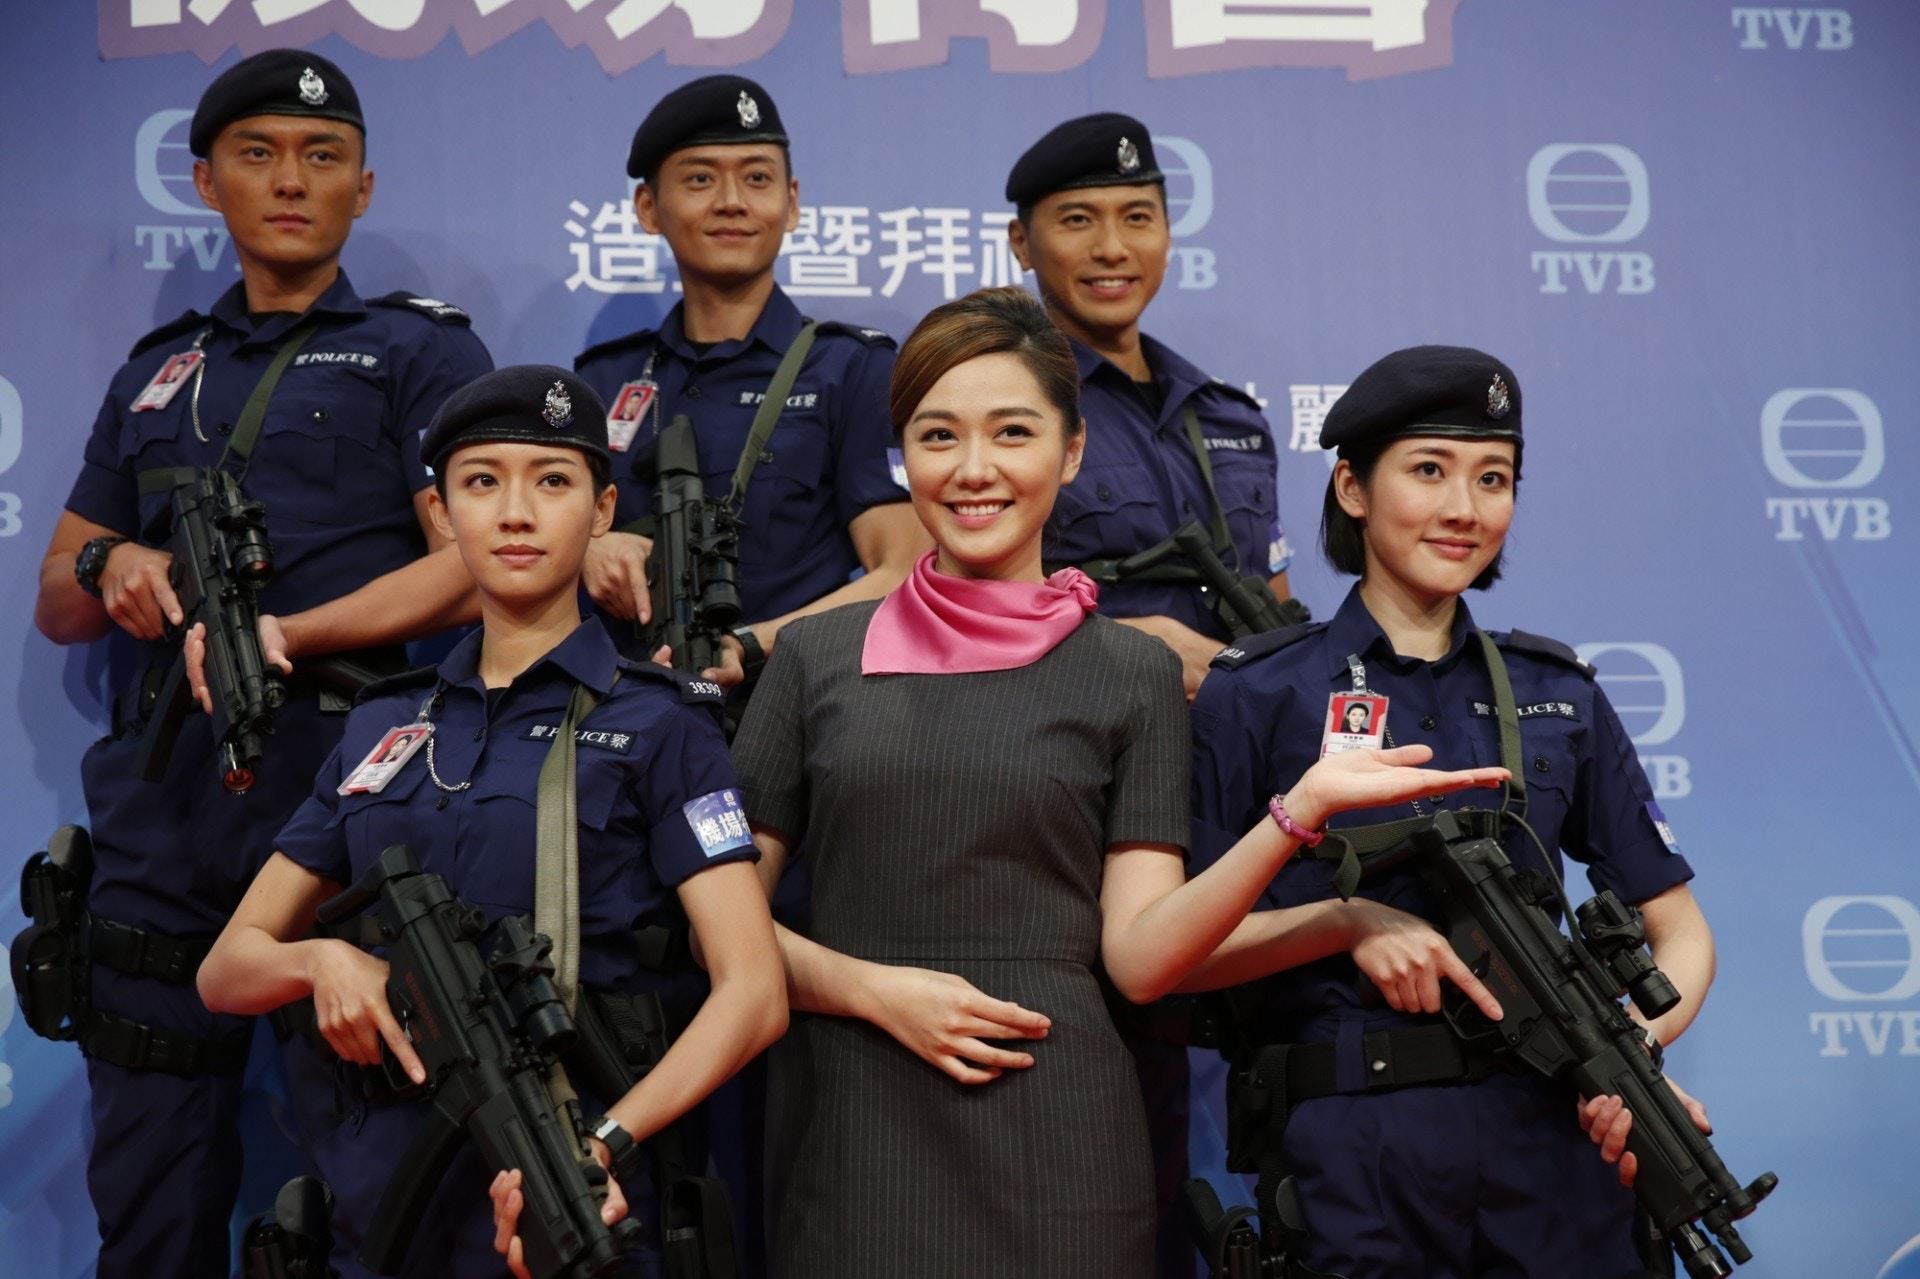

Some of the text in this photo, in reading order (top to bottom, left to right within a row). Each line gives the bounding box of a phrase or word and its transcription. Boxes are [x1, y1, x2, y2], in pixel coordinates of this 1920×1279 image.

[1731, 6, 1854, 50] TVB
[134, 224, 243, 272] TV
[563, 198, 1036, 300] 造暨拜
[1531, 250, 1656, 295] TVB
[1765, 497, 1893, 542] TVB
[546, 726, 611, 745] PLICE
